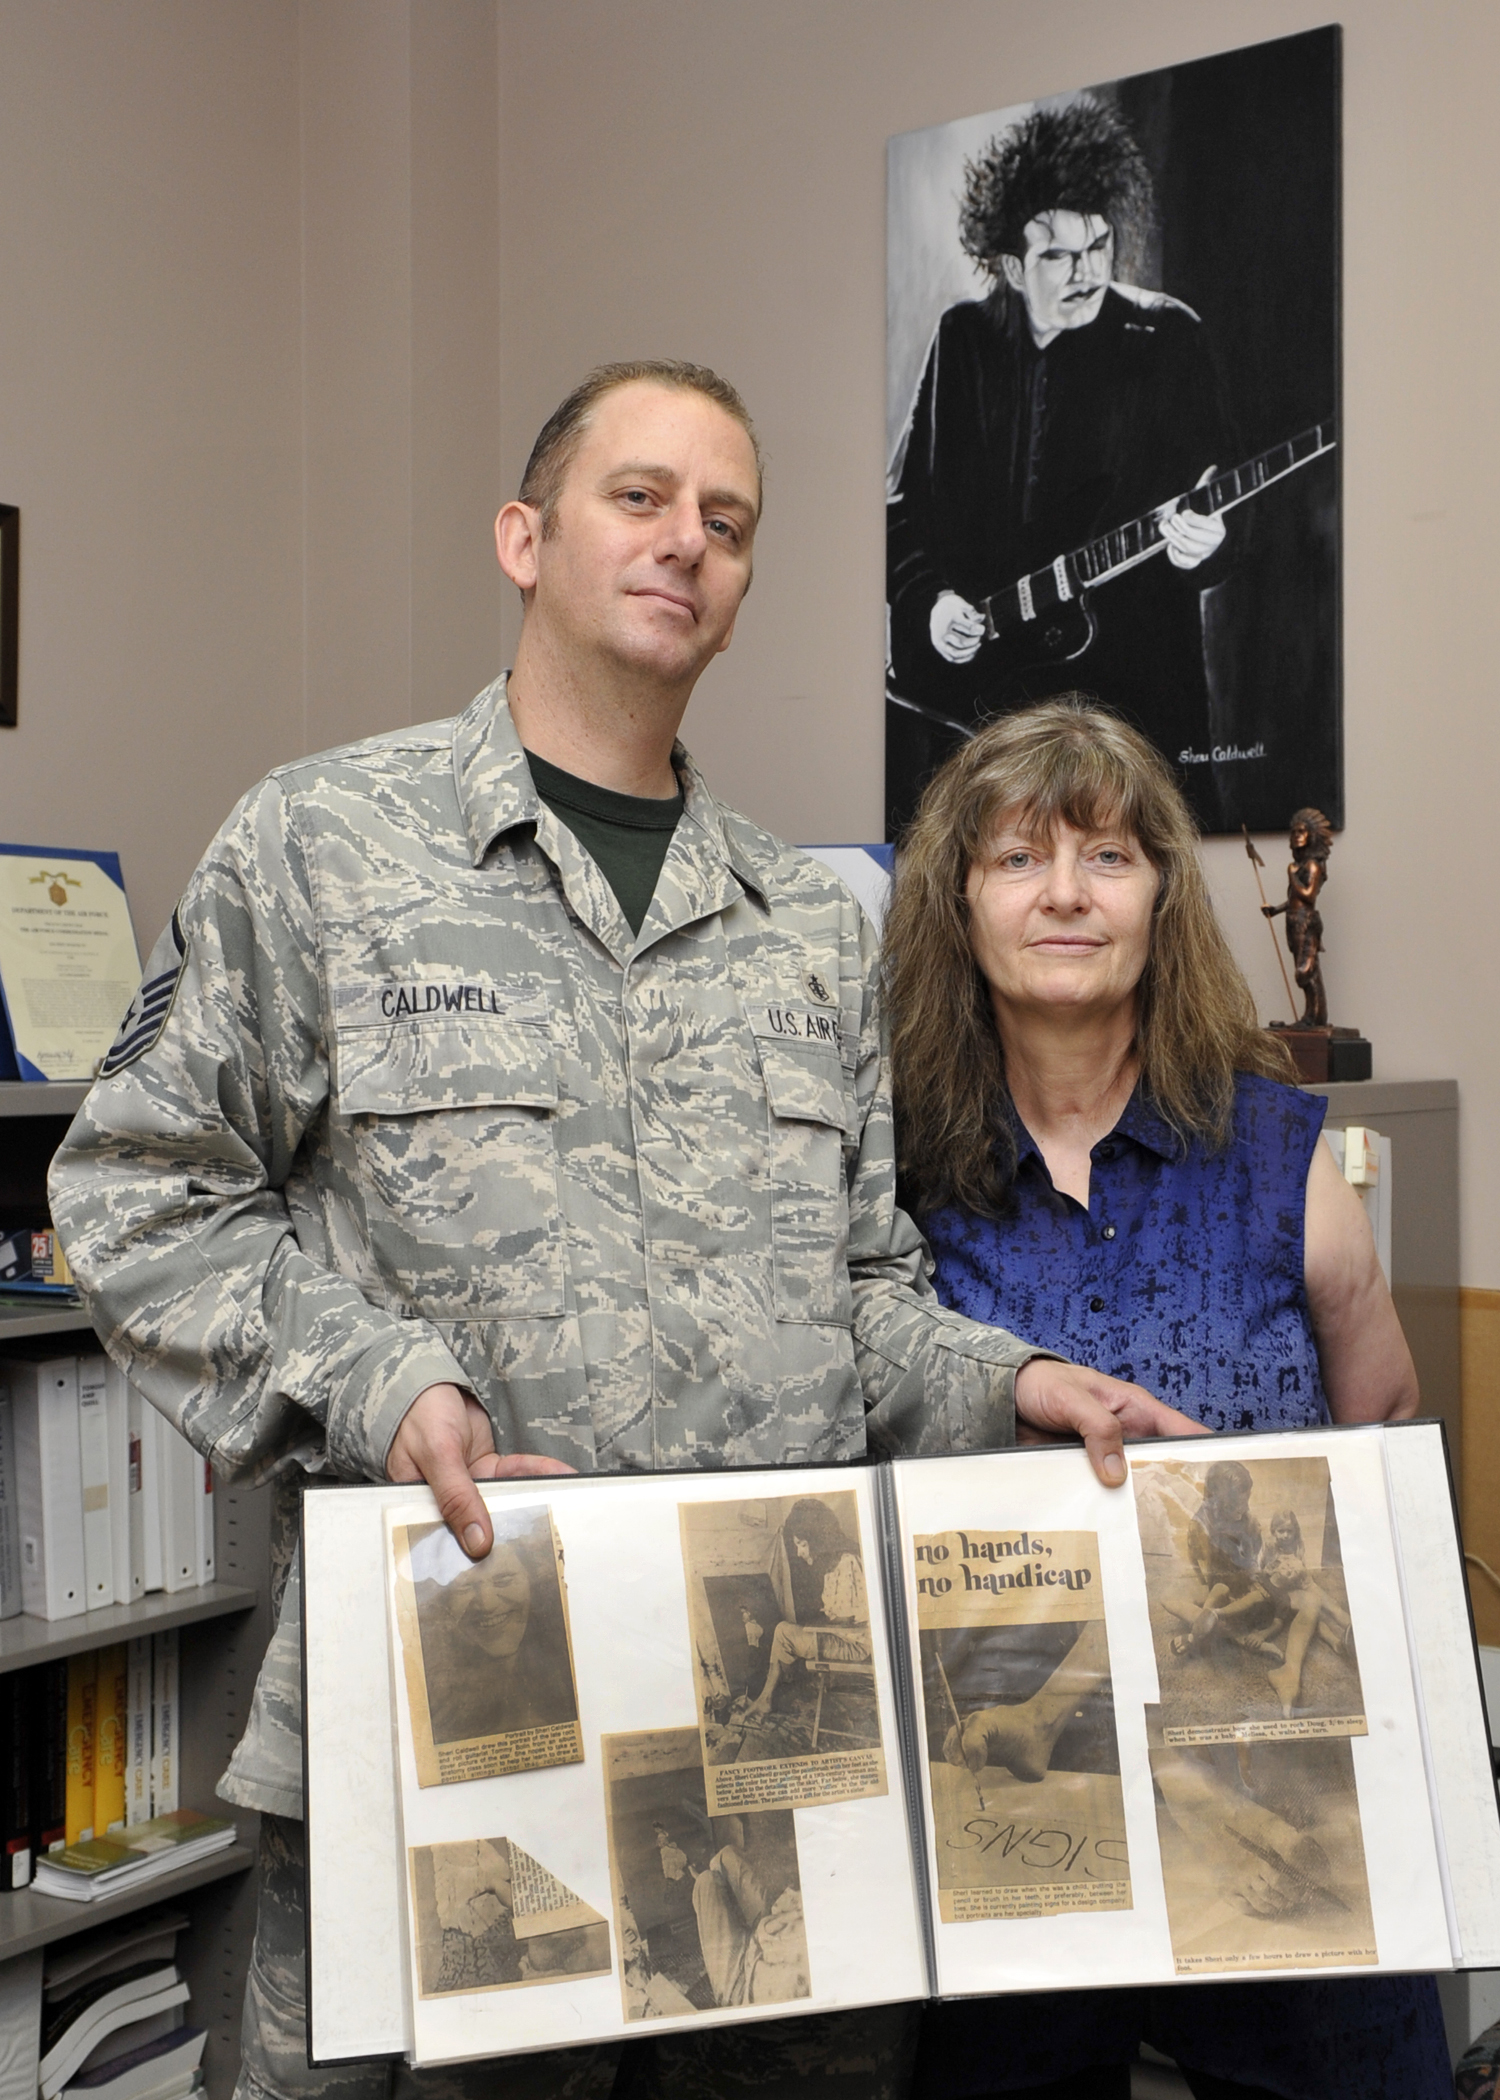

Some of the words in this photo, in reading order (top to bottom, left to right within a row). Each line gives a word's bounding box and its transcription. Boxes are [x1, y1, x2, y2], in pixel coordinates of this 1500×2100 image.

[1211, 741, 1267, 762] Caldwell
[381, 984, 506, 1017] CALDWELL
[768, 1009, 802, 1036] U.S.
[806, 1014, 832, 1041] AIR
[31, 1236, 48, 1258] 25
[916, 1544, 950, 1565] no
[956, 1531, 1053, 1563] hands,
[918, 1576, 952, 1597] no
[958, 1562, 1092, 1595] handicap
[99, 1716, 119, 1765] Care
[134, 1713, 143, 1767] EMERGENCY
[161, 1704, 170, 1757] EMERGENCY
[505, 1731, 526, 1739] Portrait
[551, 1723, 574, 1732] Caldwell
[562, 1729, 575, 1737] rock
[68, 1725, 88, 1775] Care
[134, 1768, 143, 1800] CARE
[161, 1758, 170, 1789] CARE
[720, 1768, 740, 1776] FANCY
[780, 1761, 808, 1769] EXTENDS
[1092, 1882, 1113, 1890] putting
[966, 1912, 991, 1920] portraits
[990, 1903, 1016, 1911] currently
[1018, 1902, 1042, 1910] painting
[1225, 1955, 1239, 1963] only
[1321, 1949, 1344, 1957] picture
